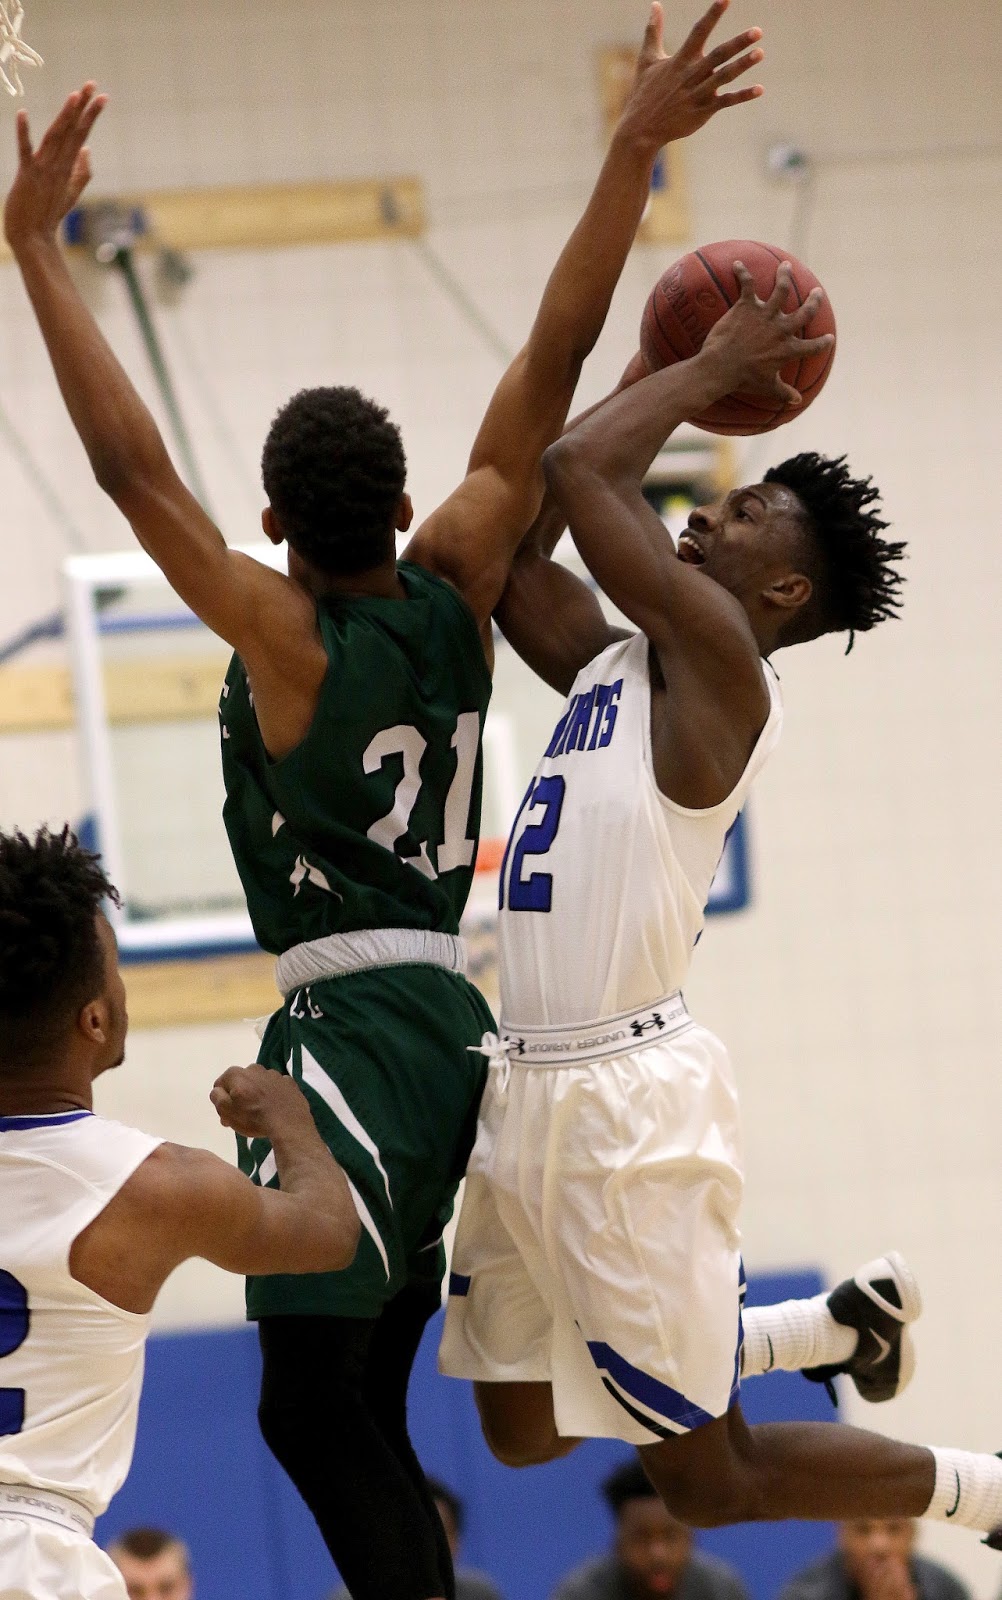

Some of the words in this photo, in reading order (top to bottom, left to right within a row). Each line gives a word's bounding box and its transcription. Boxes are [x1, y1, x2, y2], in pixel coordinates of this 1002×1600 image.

[362, 711, 480, 880] 21
[498, 774, 566, 913] 12
[528, 1041, 571, 1053] ARMOUR
[577, 1030, 626, 1050] UNDER
